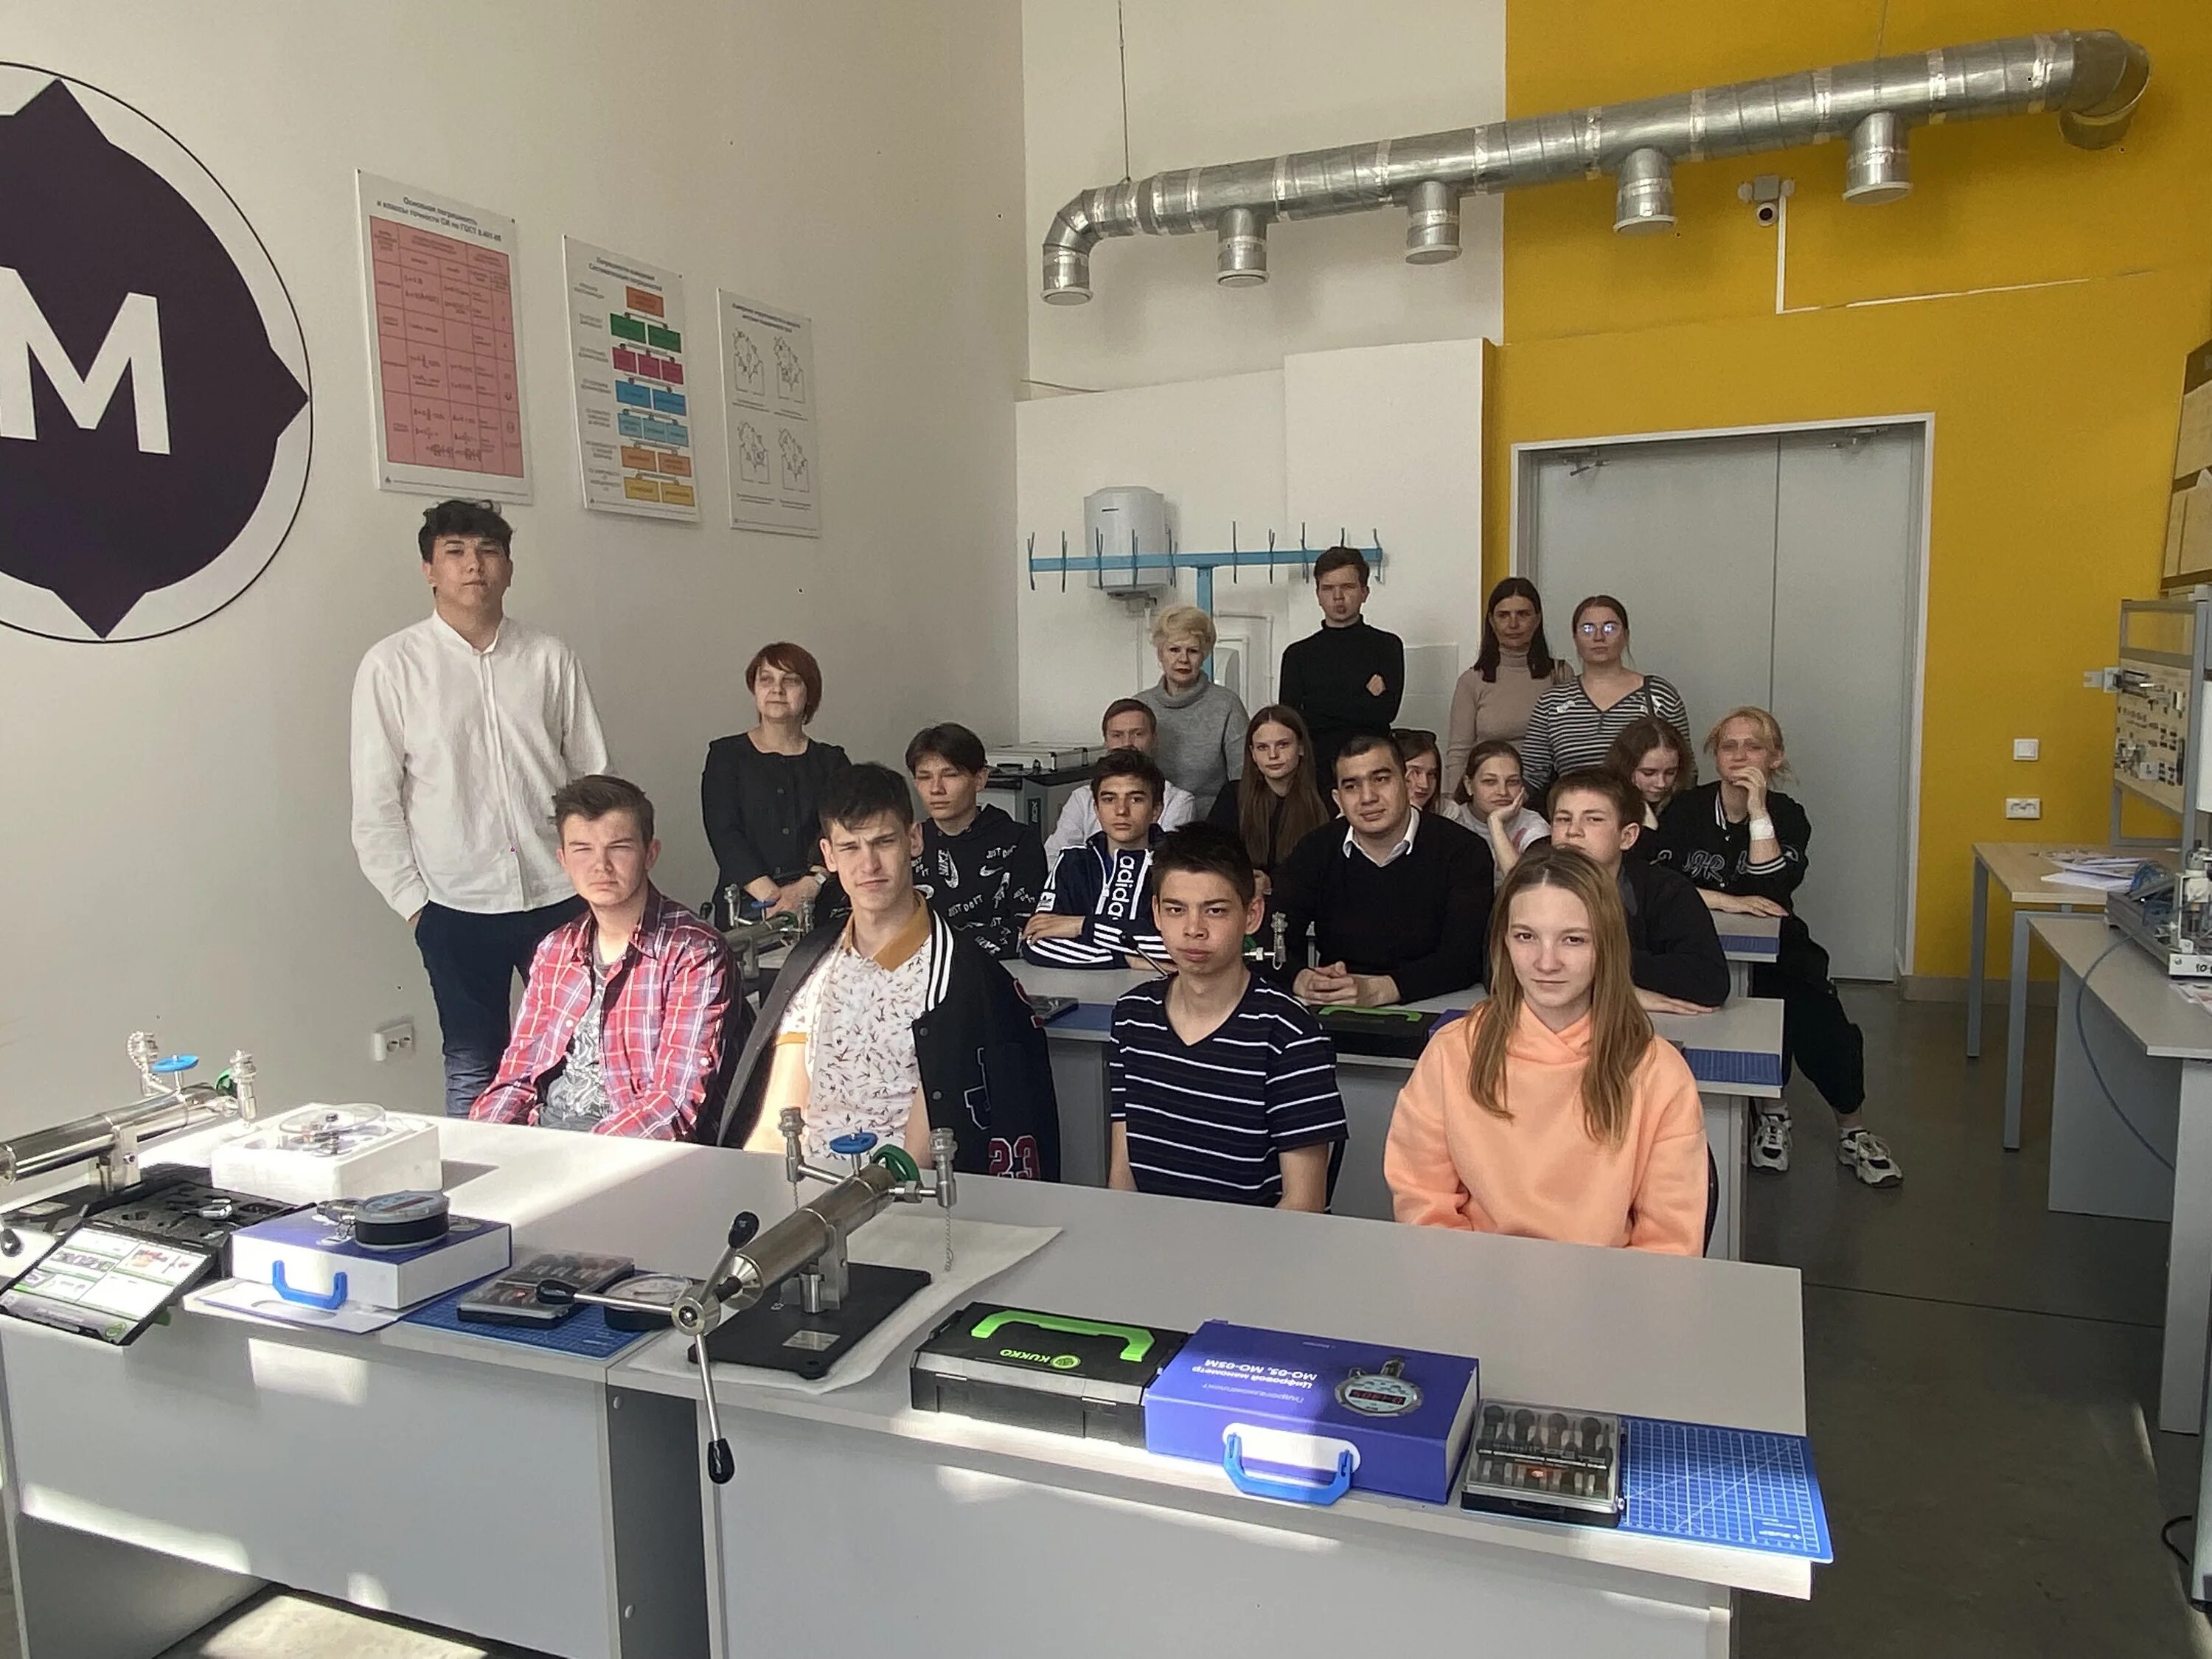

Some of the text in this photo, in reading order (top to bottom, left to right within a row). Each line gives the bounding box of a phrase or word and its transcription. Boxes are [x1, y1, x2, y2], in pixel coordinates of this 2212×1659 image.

[1107, 855, 1135, 920] adida
[989, 1135, 1041, 1180] 23
[1000, 1349, 1051, 1363] KUKKO
[1192, 1366, 1312, 1389] Цифровой манометр
